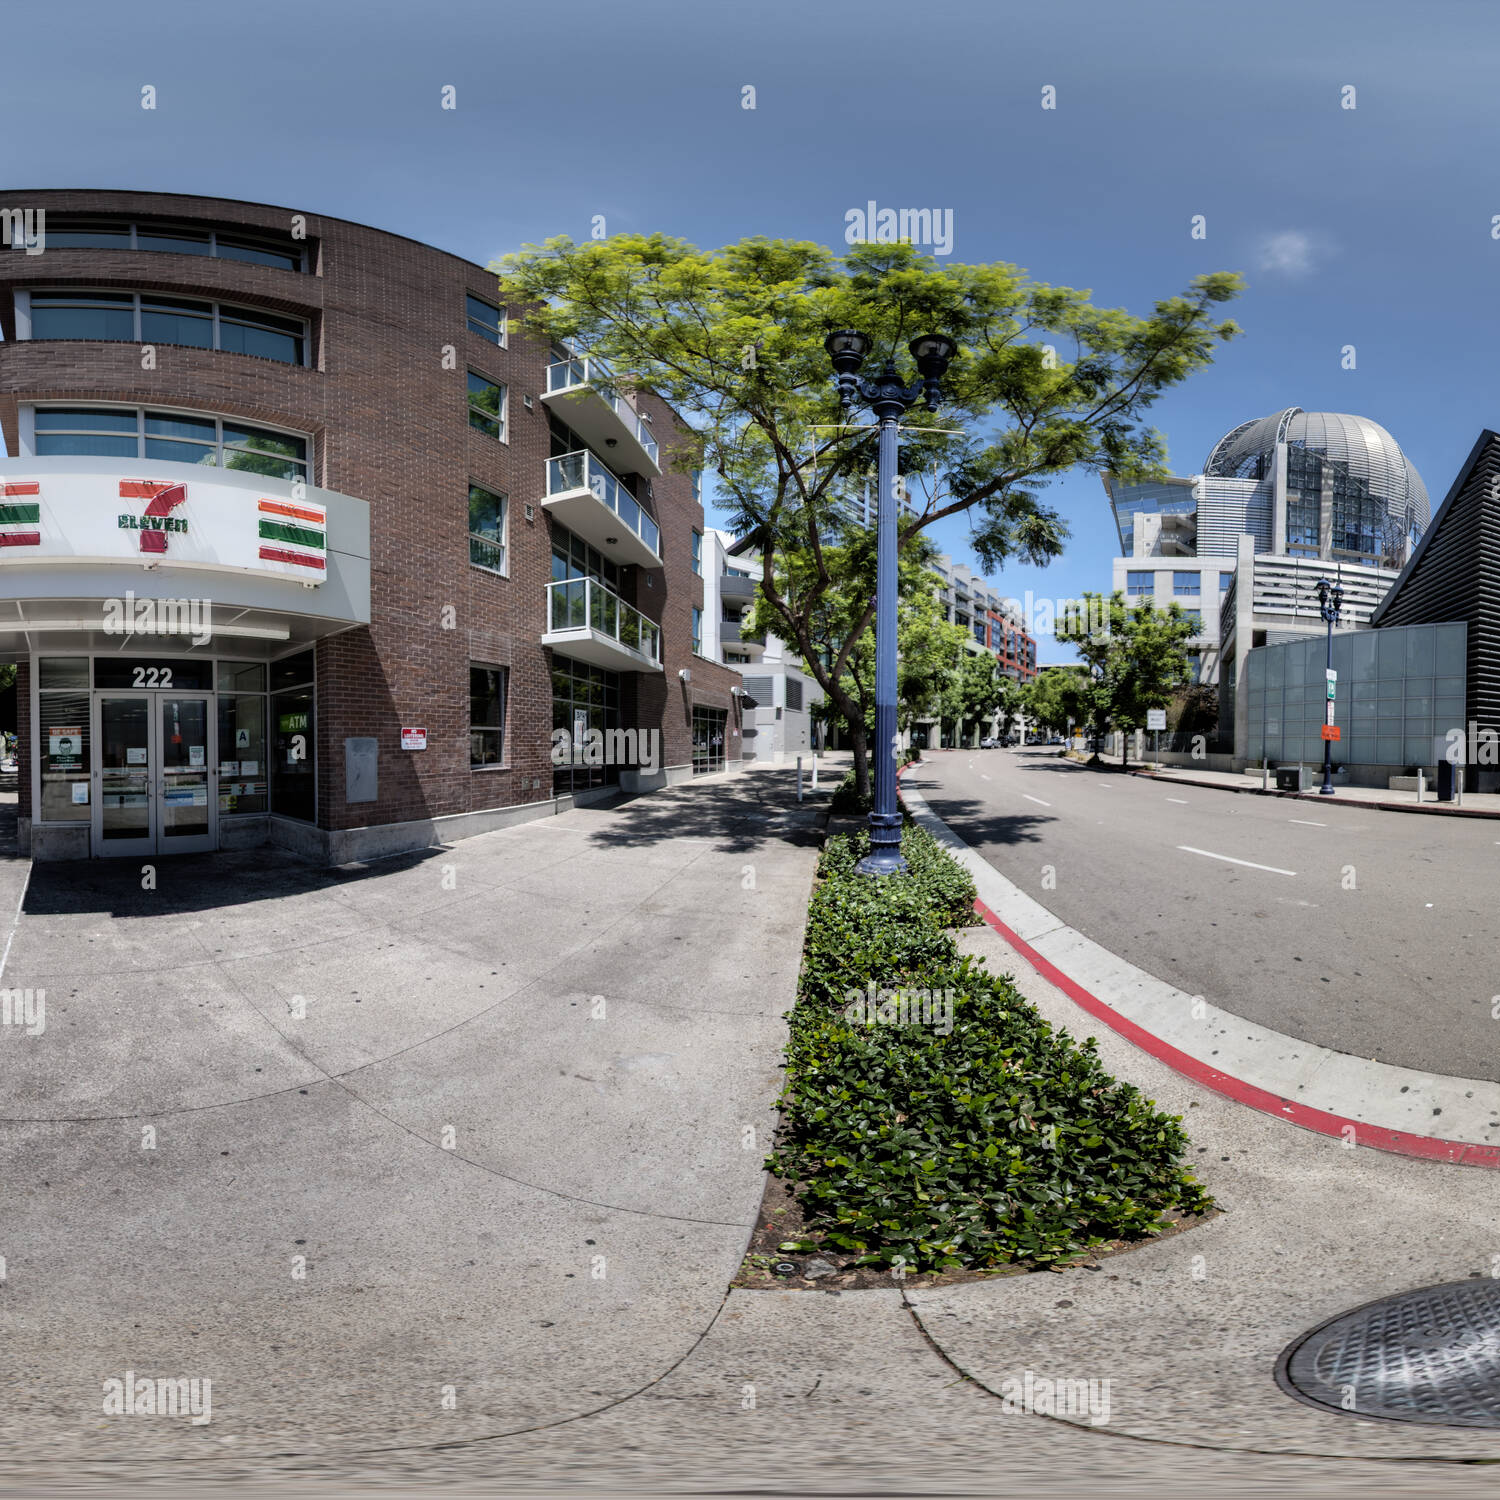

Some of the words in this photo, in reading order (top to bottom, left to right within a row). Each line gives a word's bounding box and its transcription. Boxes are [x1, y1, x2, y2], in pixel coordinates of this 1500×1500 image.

[119, 478, 187, 553] 7
[133, 667, 173, 688] 222
[289, 715, 307, 729] ATM
[239, 731, 247, 741] A
